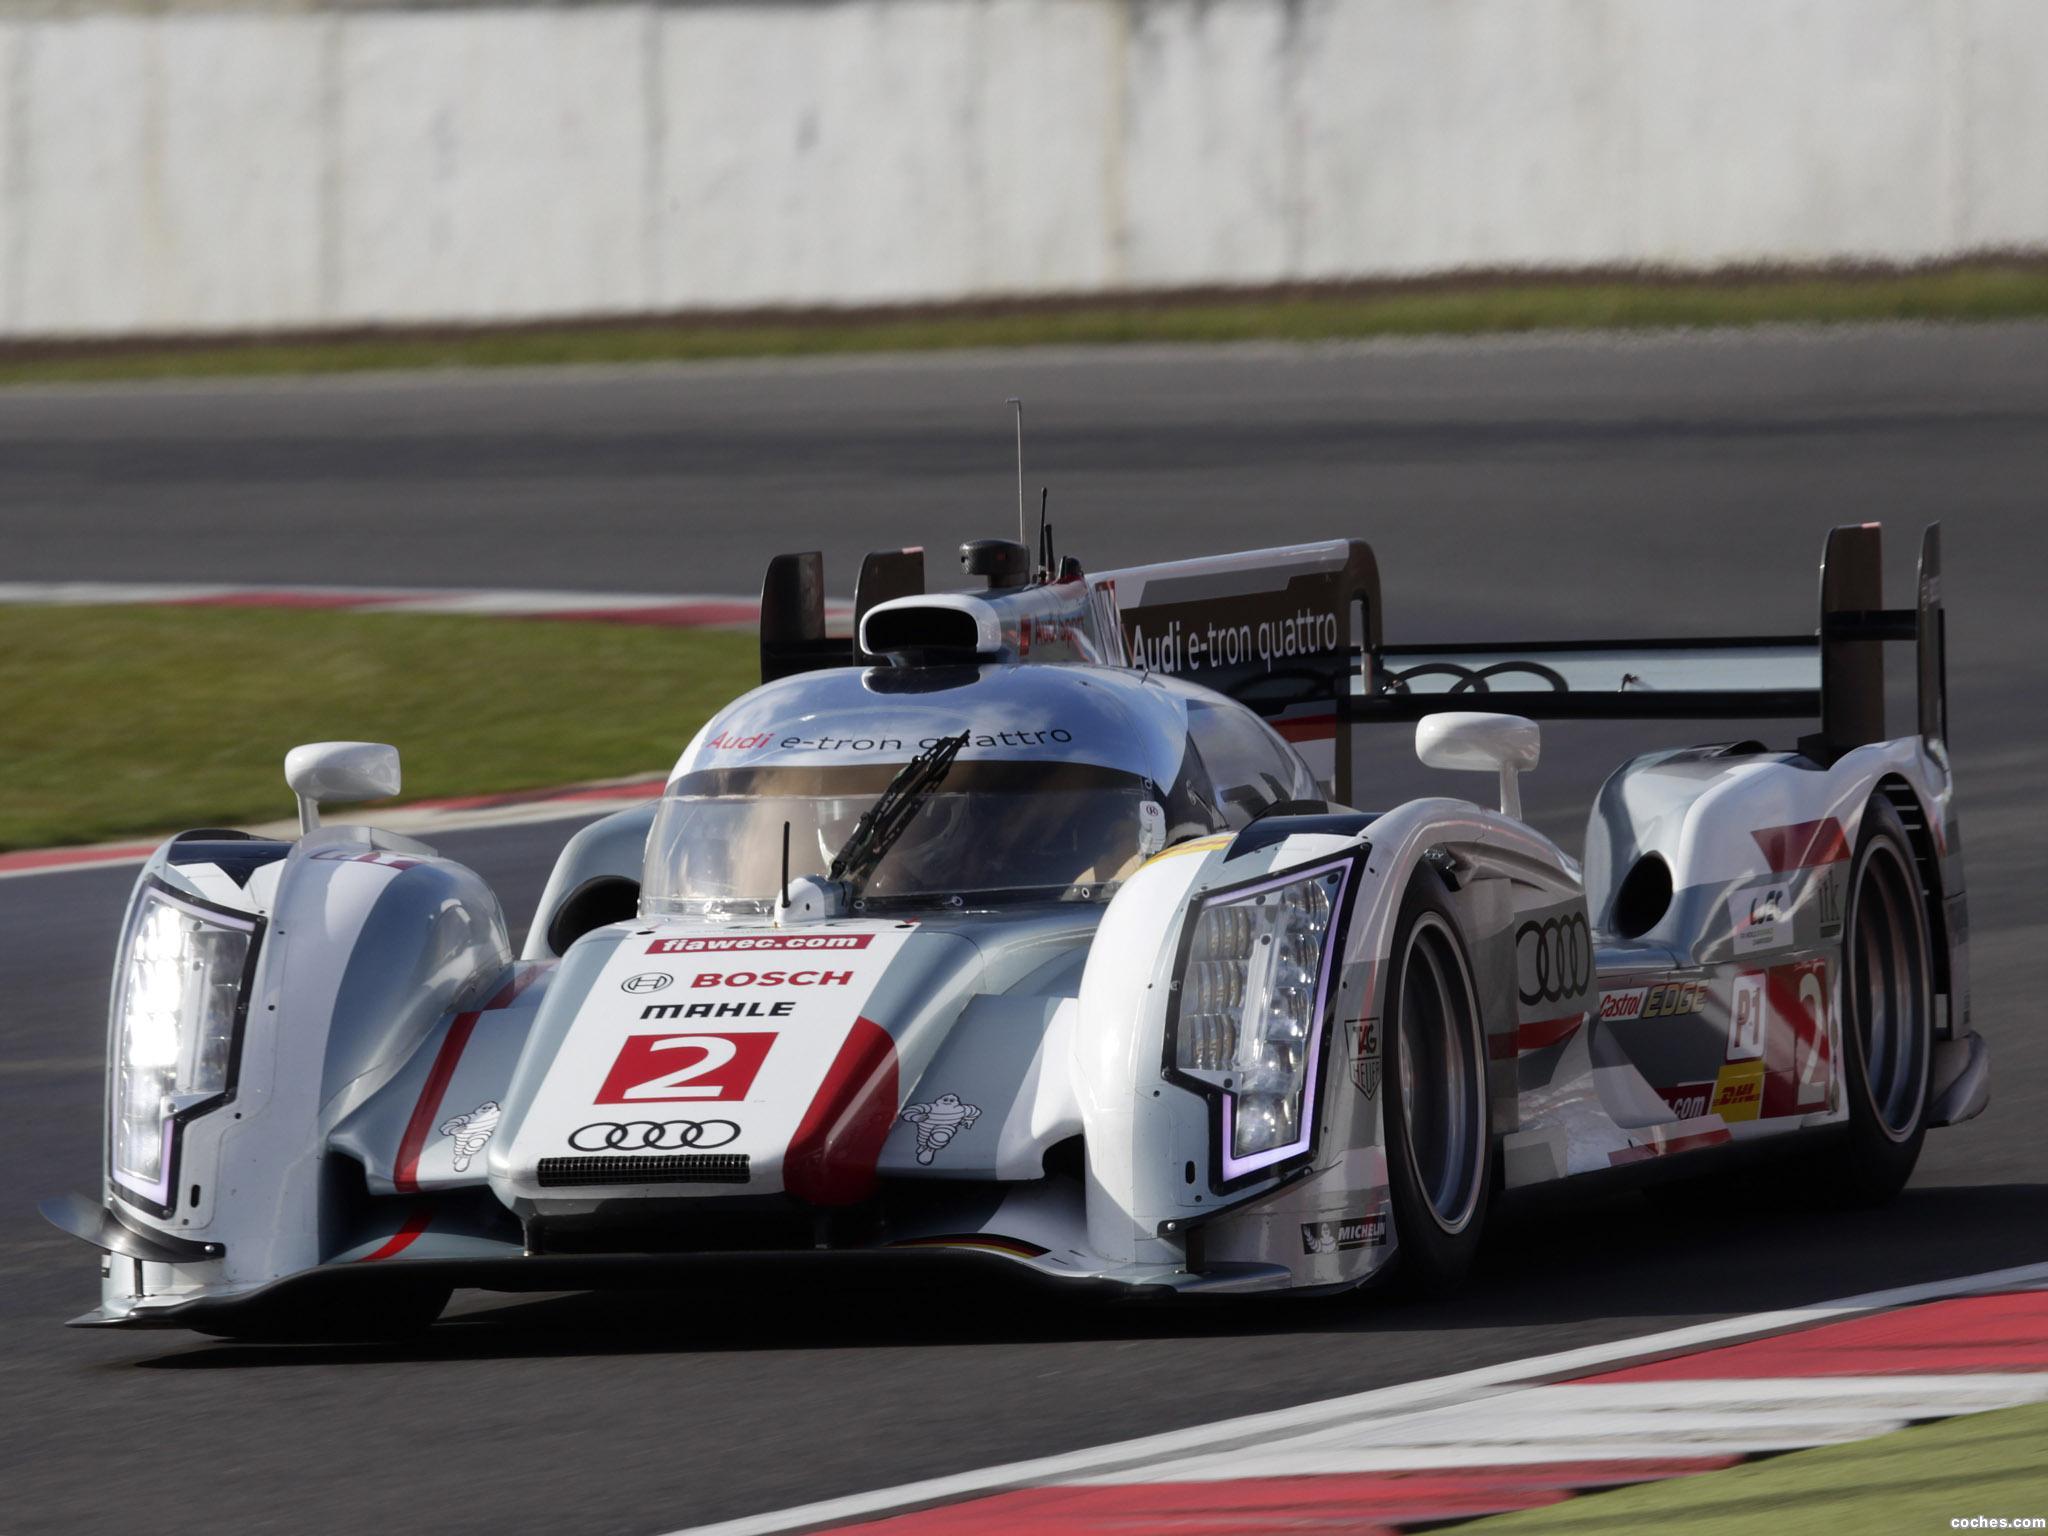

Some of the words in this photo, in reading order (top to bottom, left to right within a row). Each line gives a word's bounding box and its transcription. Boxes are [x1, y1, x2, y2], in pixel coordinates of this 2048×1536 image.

[1133, 621, 1182, 673] Audi
[1188, 622, 1251, 670] e-tron
[1259, 608, 1337, 672] quattro
[706, 730, 775, 751] Audi
[780, 734, 901, 751] e-tron
[919, 728, 1072, 752] qattro
[661, 937, 857, 951] fiawec.com
[691, 970, 854, 989] BOSCH
[640, 1001, 797, 1020] MAHLE
[1600, 992, 1643, 1018] Castrol
[1643, 980, 1710, 1019] EDGE
[1734, 987, 1761, 1048] P1
[1352, 1024, 1377, 1055] TAG
[1797, 972, 1827, 1106] 2
[623, 1036, 738, 1100] 2
[1714, 1083, 1757, 1106] DHL
[1337, 1221, 1386, 1241] MICHELIN
